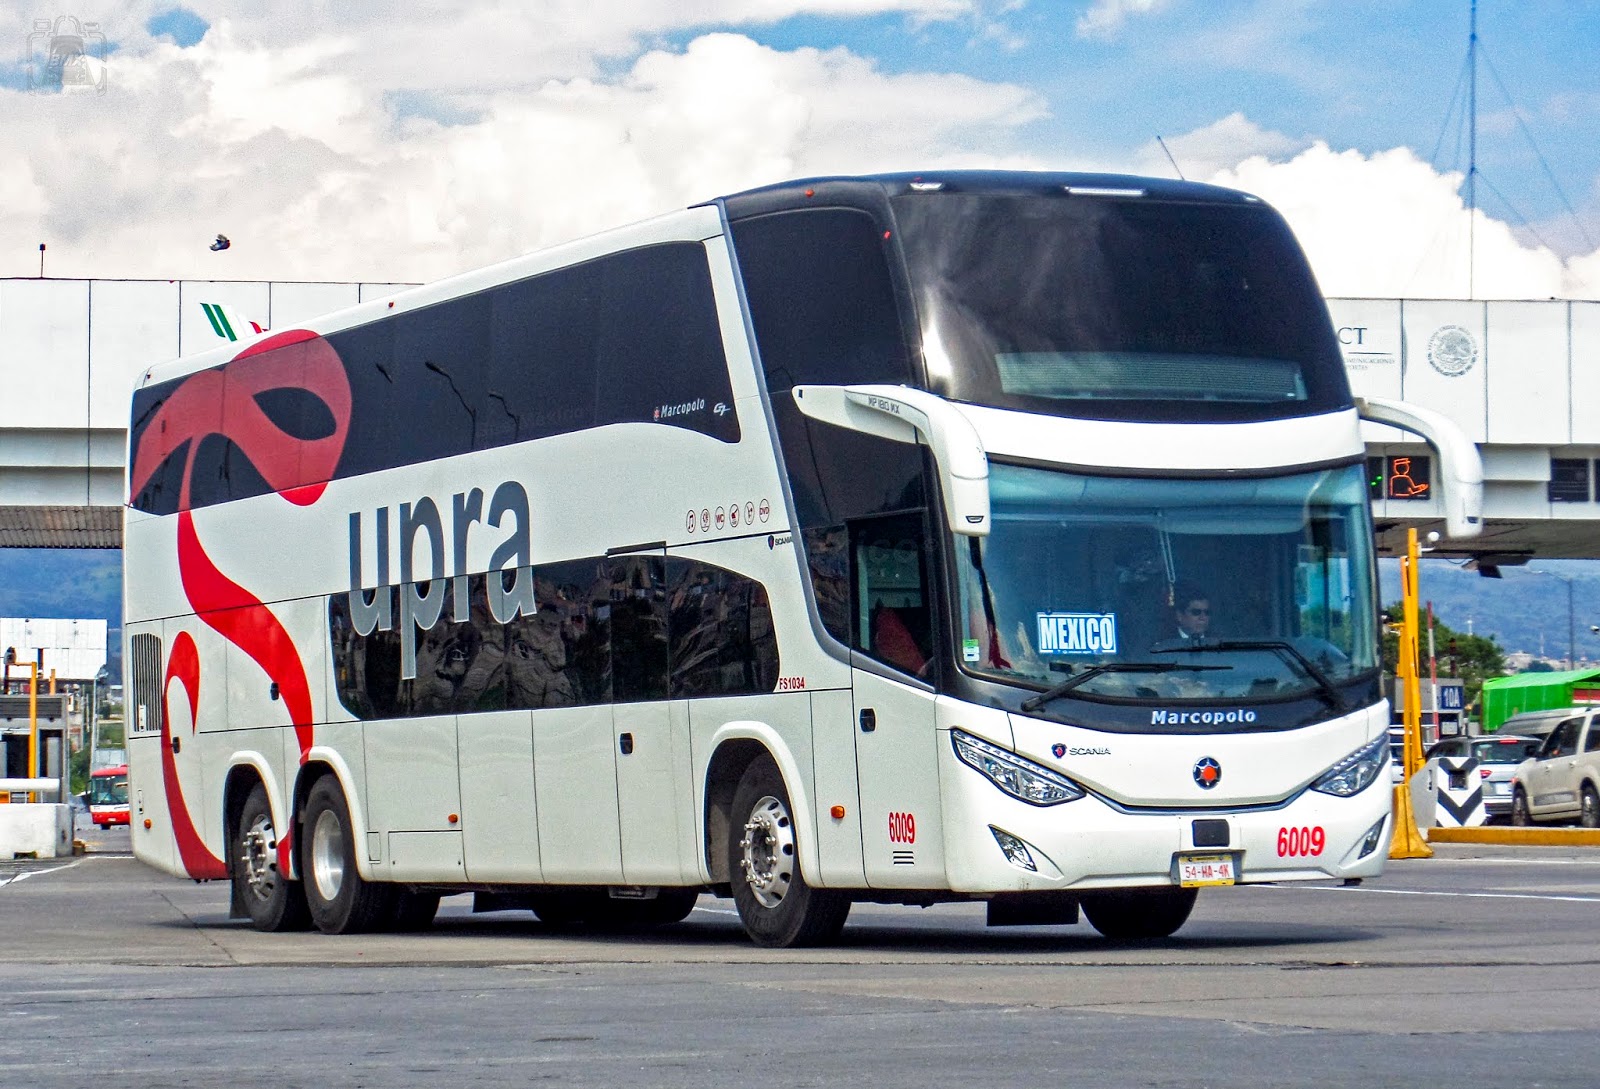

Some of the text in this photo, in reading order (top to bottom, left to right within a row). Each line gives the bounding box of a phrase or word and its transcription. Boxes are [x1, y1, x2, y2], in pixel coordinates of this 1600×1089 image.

[1337, 326, 1368, 345] CT
[660, 397, 706, 418] Marcopolo
[715, 513, 725, 523] WC
[759, 506, 770, 516] DVD
[348, 480, 538, 681] upra
[1039, 617, 1114, 650] MEXICO
[778, 676, 806, 690] FS1034
[1443, 688, 1461, 707] 10A
[1150, 709, 1257, 726] Marcopolo
[1068, 747, 1112, 756] SCANIA
[888, 811, 916, 845] 6009
[1276, 825, 1326, 858] 6009
